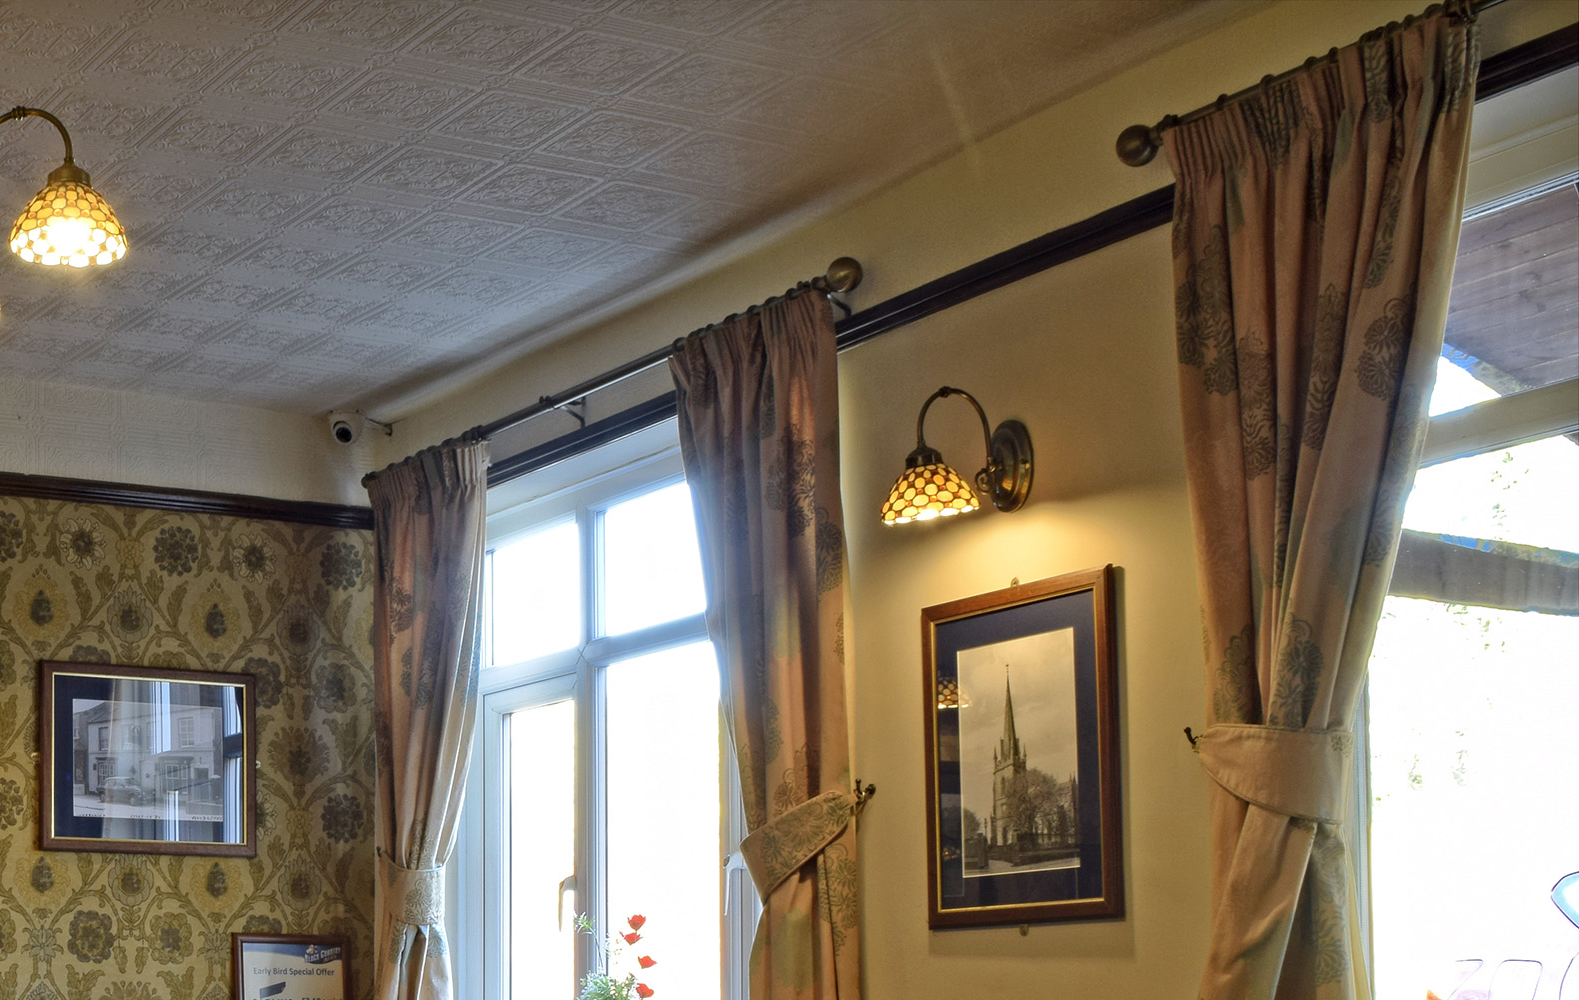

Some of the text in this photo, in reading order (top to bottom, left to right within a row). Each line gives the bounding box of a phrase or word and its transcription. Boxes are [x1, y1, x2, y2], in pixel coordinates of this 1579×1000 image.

[253, 967, 335, 976] Early Bird Special Offer
